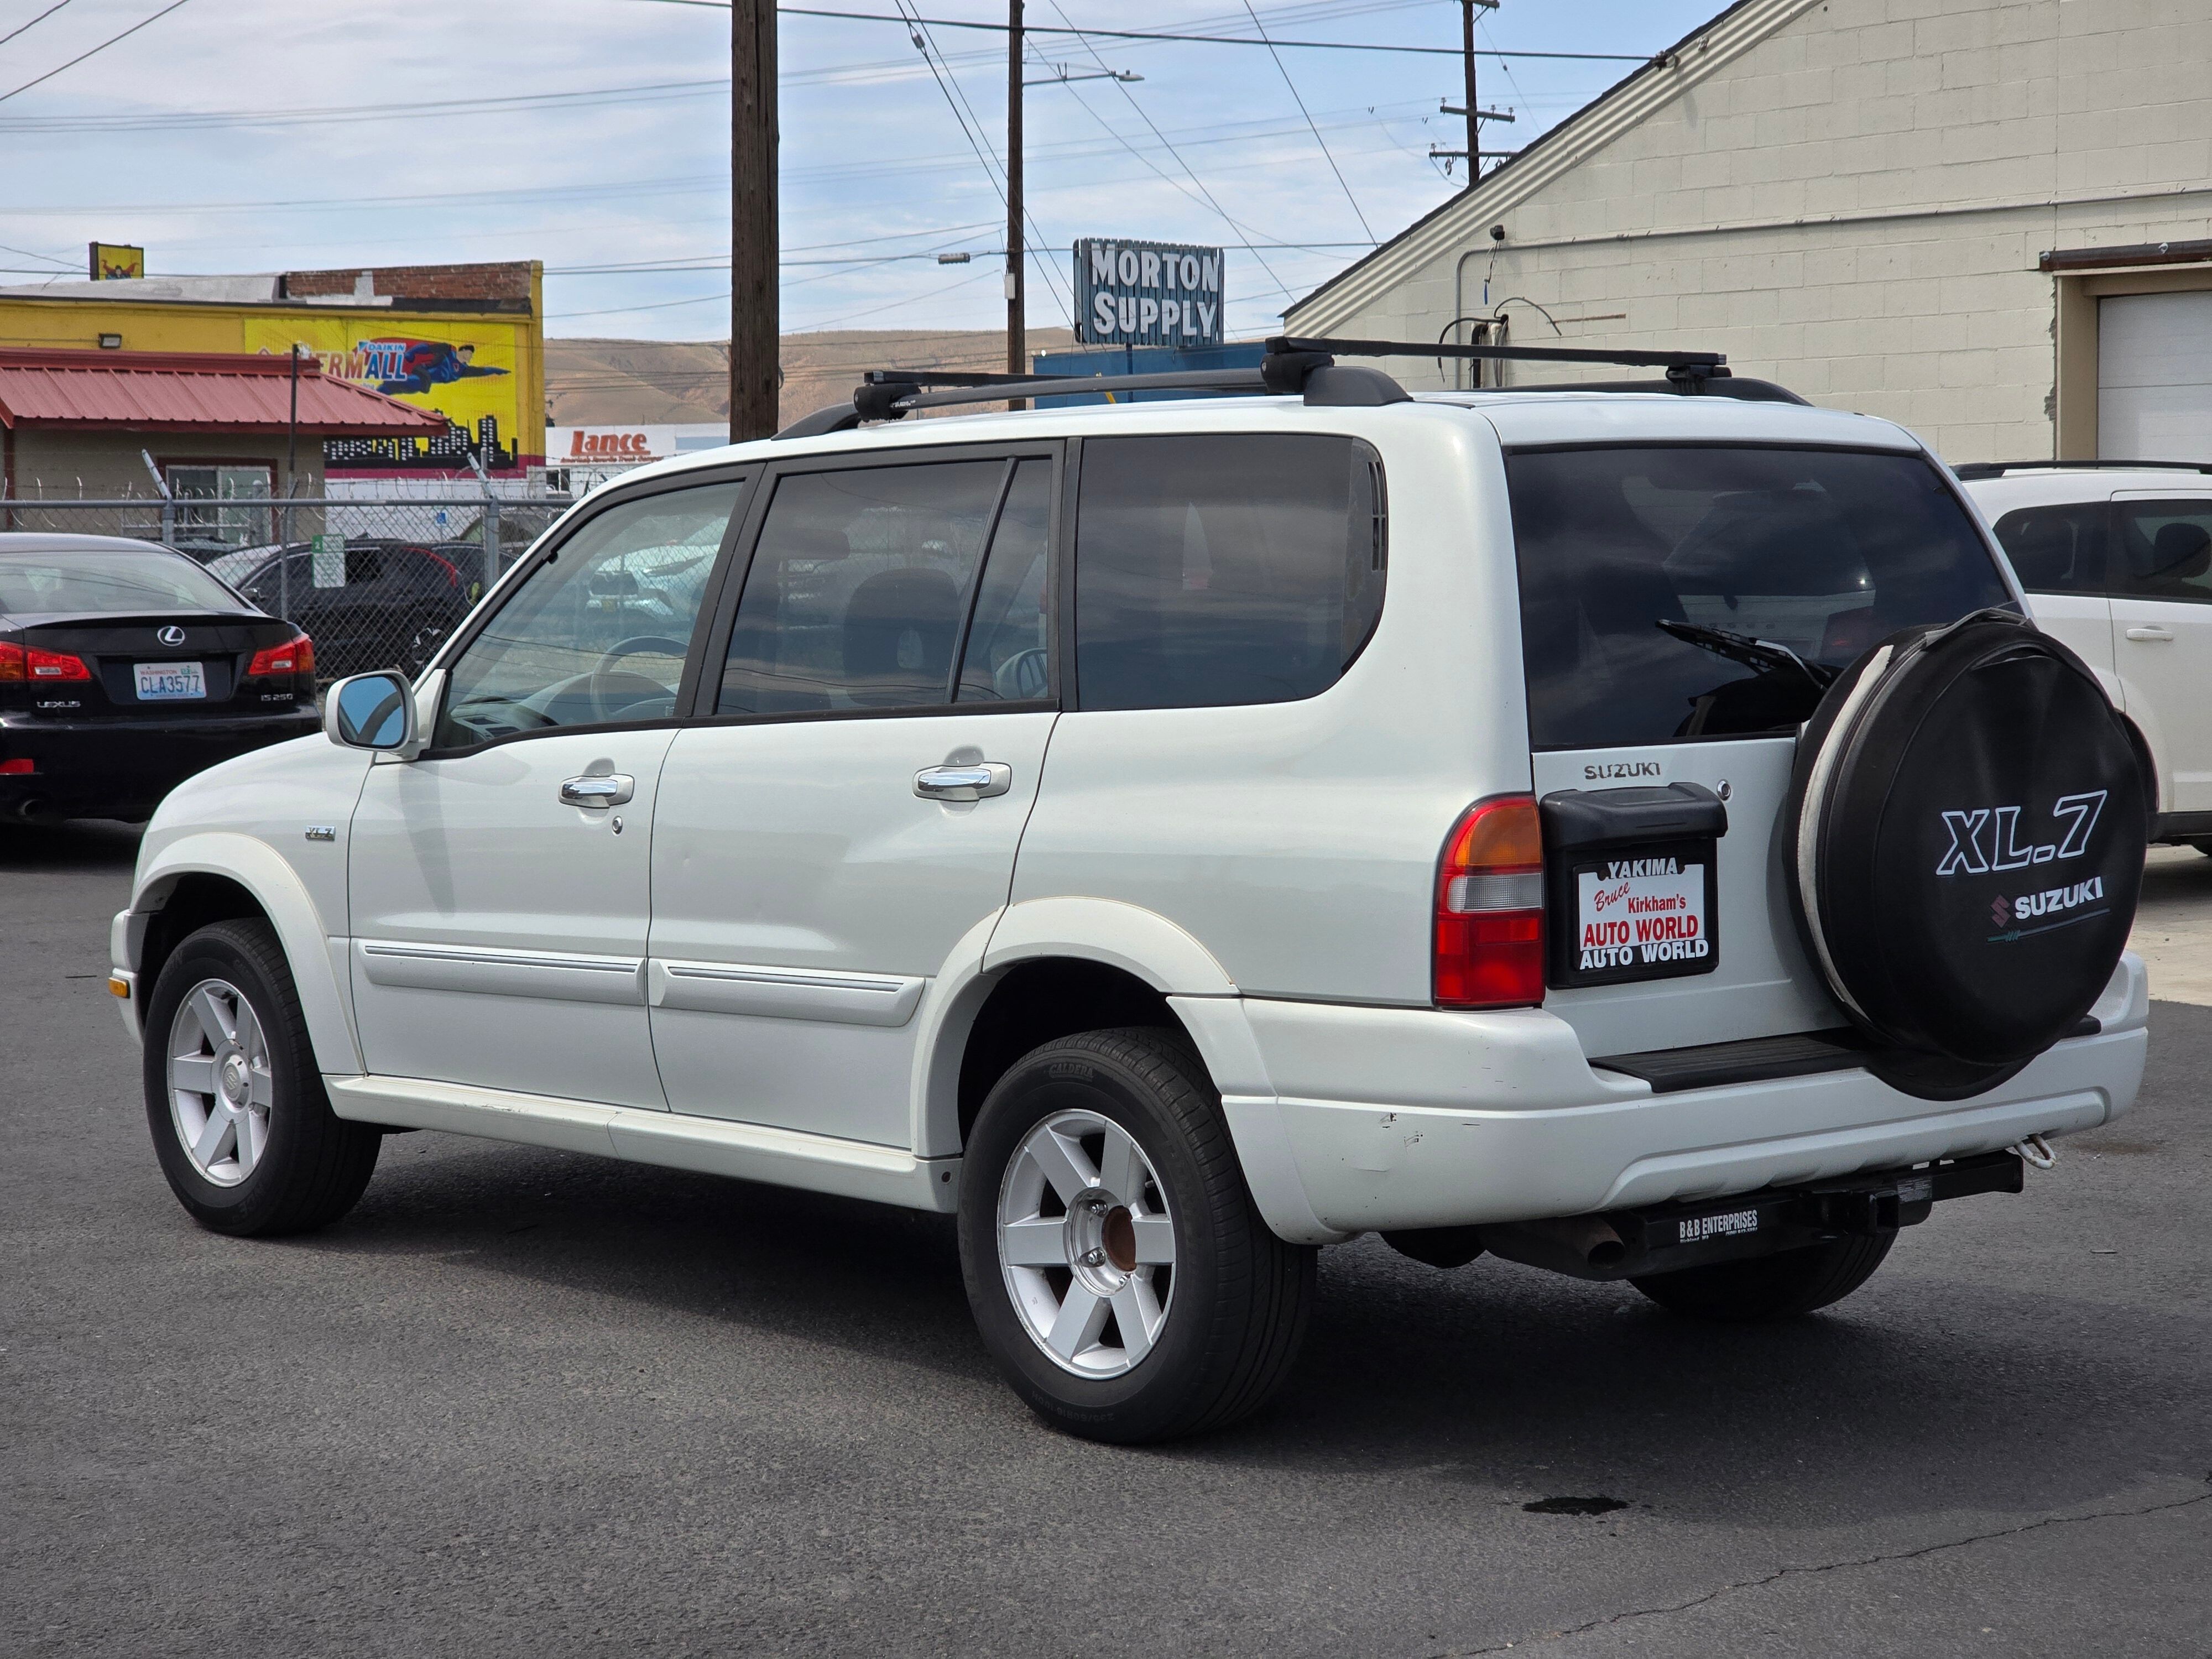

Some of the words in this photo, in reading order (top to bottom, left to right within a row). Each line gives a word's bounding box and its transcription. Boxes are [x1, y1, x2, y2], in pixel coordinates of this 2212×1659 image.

[1091, 243, 1219, 292] MORTON
[1093, 291, 1216, 337] SUPPLY
[570, 430, 651, 456] Lance
[140, 675, 200, 693] CLA3577
[1584, 762, 1661, 780] SUZUKI
[1608, 857, 1678, 879] YAKIMA
[1594, 882, 1631, 911] Bruce
[1627, 894, 1686, 913] Kirkham's
[2015, 877, 2103, 919] SUZUKI
[1583, 921, 1630, 947] AUTO
[1636, 915, 1698, 942] WORLD
[1579, 946, 1633, 970] AUTO
[1641, 940, 1709, 963] WORLD
[1703, 1209, 1757, 1234] ENTERPRISES
